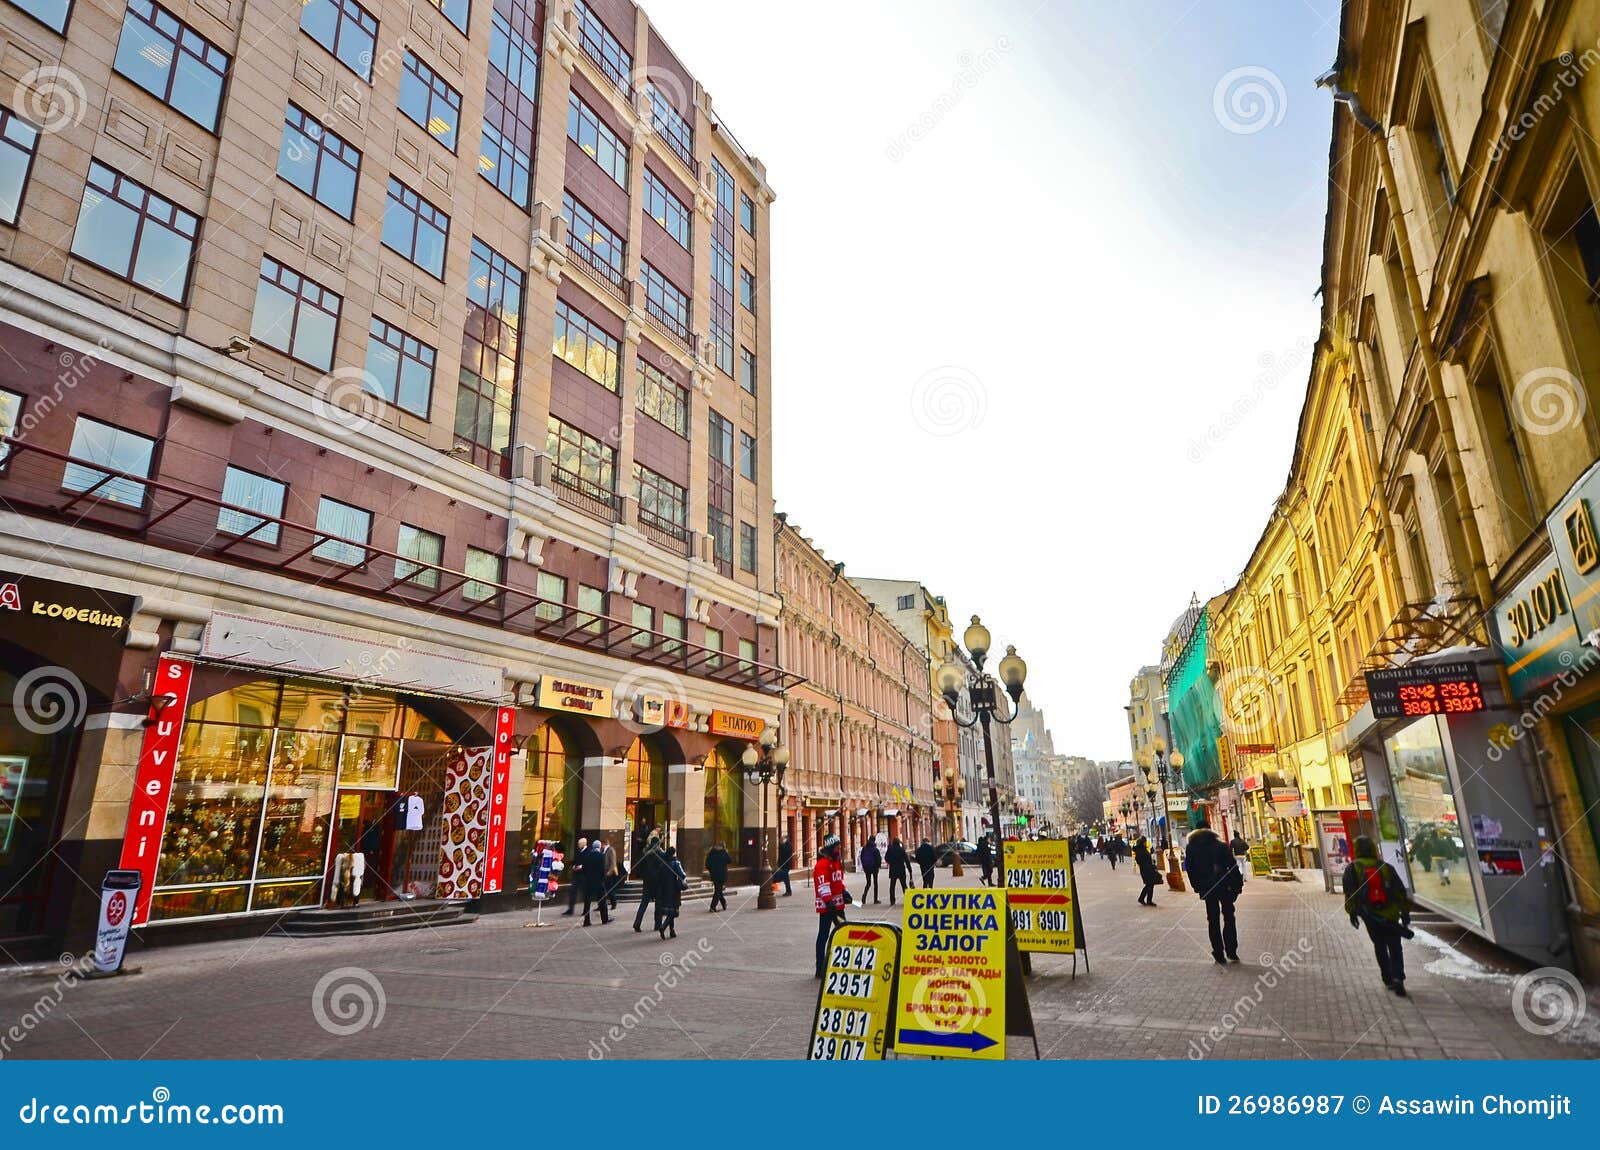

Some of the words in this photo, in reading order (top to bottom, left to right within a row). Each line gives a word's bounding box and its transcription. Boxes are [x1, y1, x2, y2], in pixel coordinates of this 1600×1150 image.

[32, 601, 123, 628] КОФЕЙНЯ
[1373, 691, 1394, 700] USD
[1377, 705, 1399, 714] EUR
[728, 716, 757, 733] ПАТИО
[488, 712, 509, 890] souvenirs
[1008, 869, 1032, 888] 2942
[1041, 869, 1066, 888] 2951
[912, 894, 996, 909] СКУПКА
[908, 913, 999, 933] ОЦЕНКА
[1040, 911, 1066, 930] 3907
[916, 934, 988, 952] ЗАЛОГ
[832, 946, 875, 970] 2942
[913, 954, 945, 966] ЧАСЫ,
[947, 955, 988, 965] ЗОЛОТО
[882, 962, 892, 982] $
[902, 966, 949, 978] СЕРЕБРО,
[952, 967, 1002, 979] НАГРАДЫ
[827, 972, 871, 997] 2951
[927, 979, 971, 990] МОНЕТЫ
[930, 991, 968, 1002] ИКОНЫ
[820, 1008, 868, 1037] 3891
[814, 1037, 865, 1060] 3907
